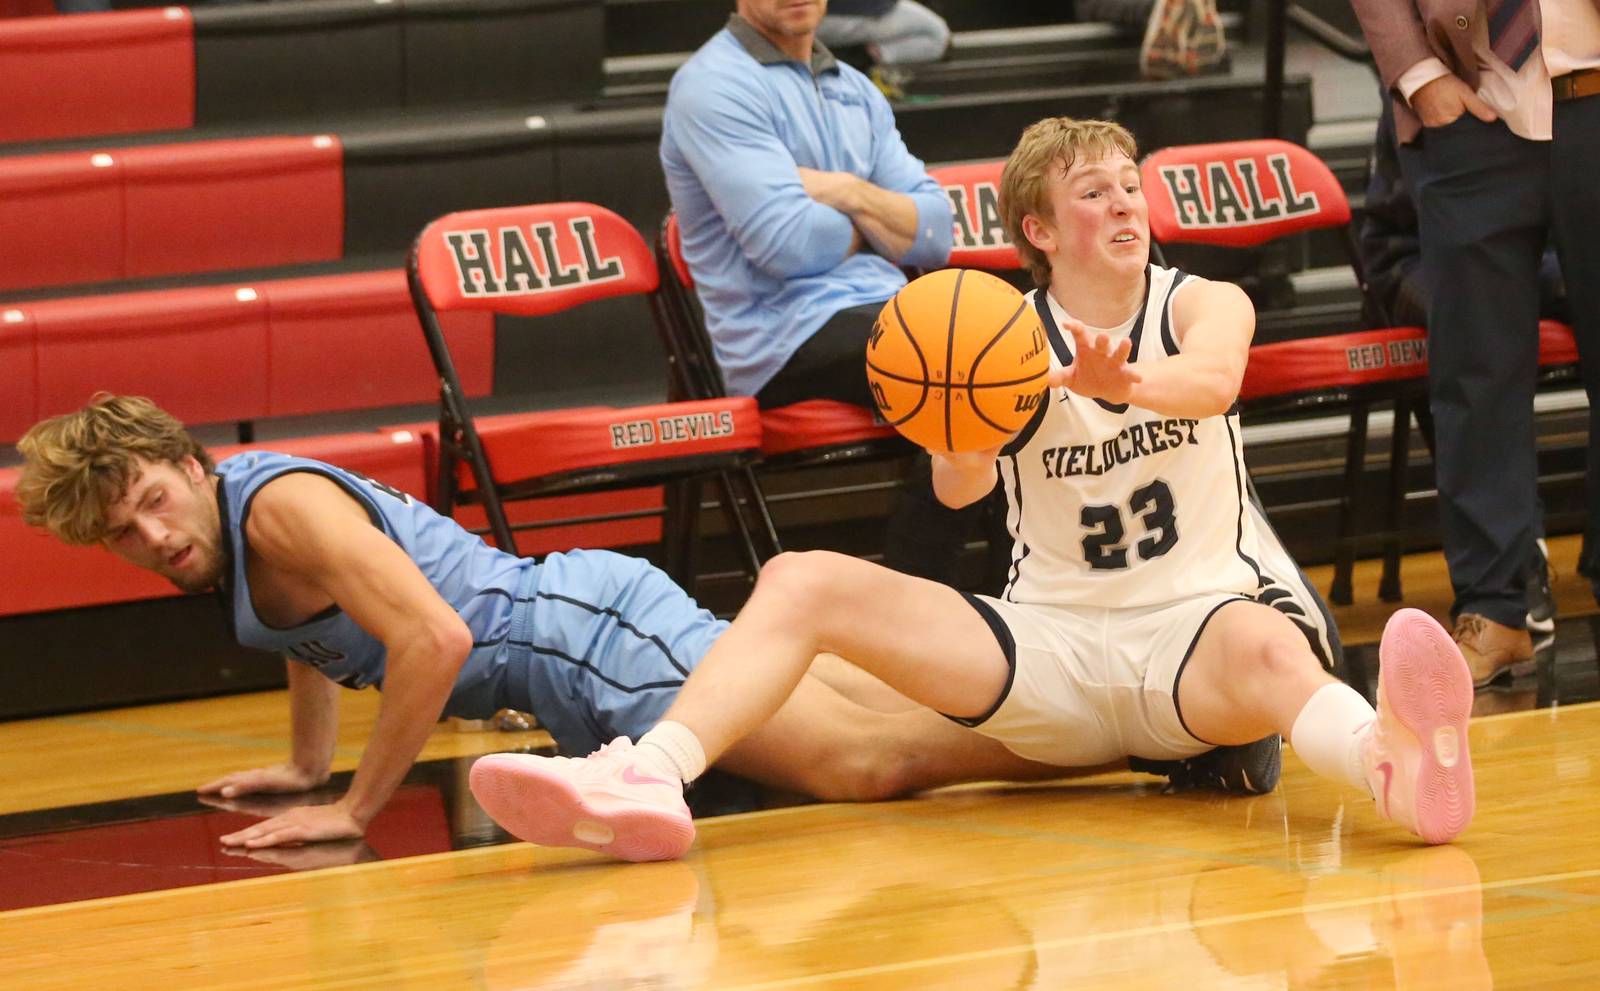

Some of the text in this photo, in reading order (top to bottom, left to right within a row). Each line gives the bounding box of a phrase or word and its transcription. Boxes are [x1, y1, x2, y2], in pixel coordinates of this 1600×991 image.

[943, 183, 1016, 250] HA
[1160, 155, 1318, 227] HALL
[445, 217, 623, 296] HALL
[1346, 339, 1427, 371] RED DEV
[610, 411, 734, 448] RED DEVILS
[1042, 418, 1199, 479] FIELDCREST
[1078, 478, 1180, 571] 23
